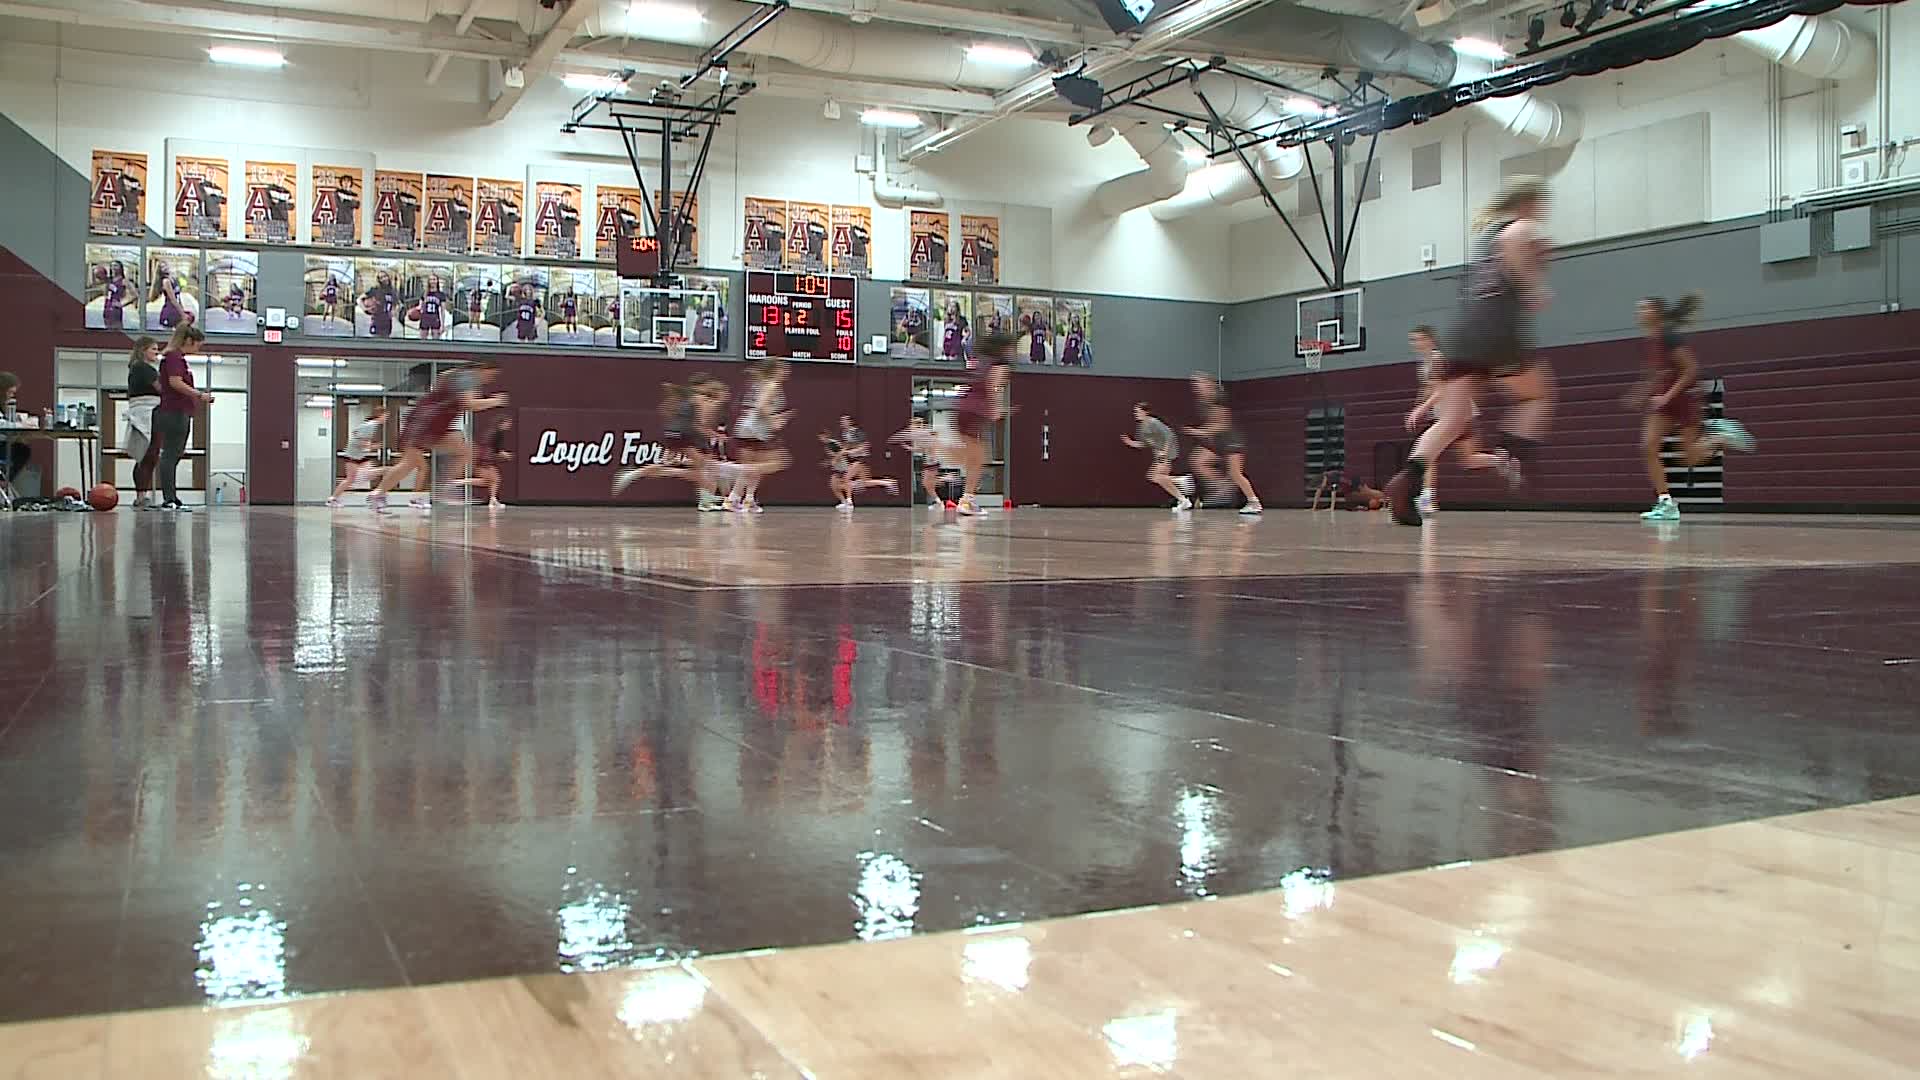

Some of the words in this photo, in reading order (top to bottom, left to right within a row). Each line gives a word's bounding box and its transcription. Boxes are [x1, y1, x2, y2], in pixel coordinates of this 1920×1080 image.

[91, 169, 122, 210] A
[176, 175, 205, 216] A
[245, 184, 269, 224] A
[312, 187, 337, 225] A
[374, 191, 399, 226] A
[425, 198, 450, 233] A
[476, 198, 499, 234] A
[536, 198, 560, 235] A
[597, 204, 620, 240] A
[632, 238, 656, 251] 1:04
[745, 217, 765, 252] A
[788, 219, 810, 254] A
[832, 224, 853, 257] A
[911, 233, 929, 267] A
[961, 235, 978, 272] A
[749, 294, 789, 305] MAROONS
[796, 275, 827, 293] 1:04
[763, 306, 779, 324] 13
[792, 301, 812, 309] PERIOD
[797, 309, 807, 324] 2
[825, 298, 852, 308] GUEST
[836, 310, 852, 328] 15
[755, 333, 765, 347] 2
[785, 327, 805, 335] PLAYER
[806, 328, 821, 336] FOUL
[838, 337, 851, 351] 10
[530, 430, 614, 472] Loyal
